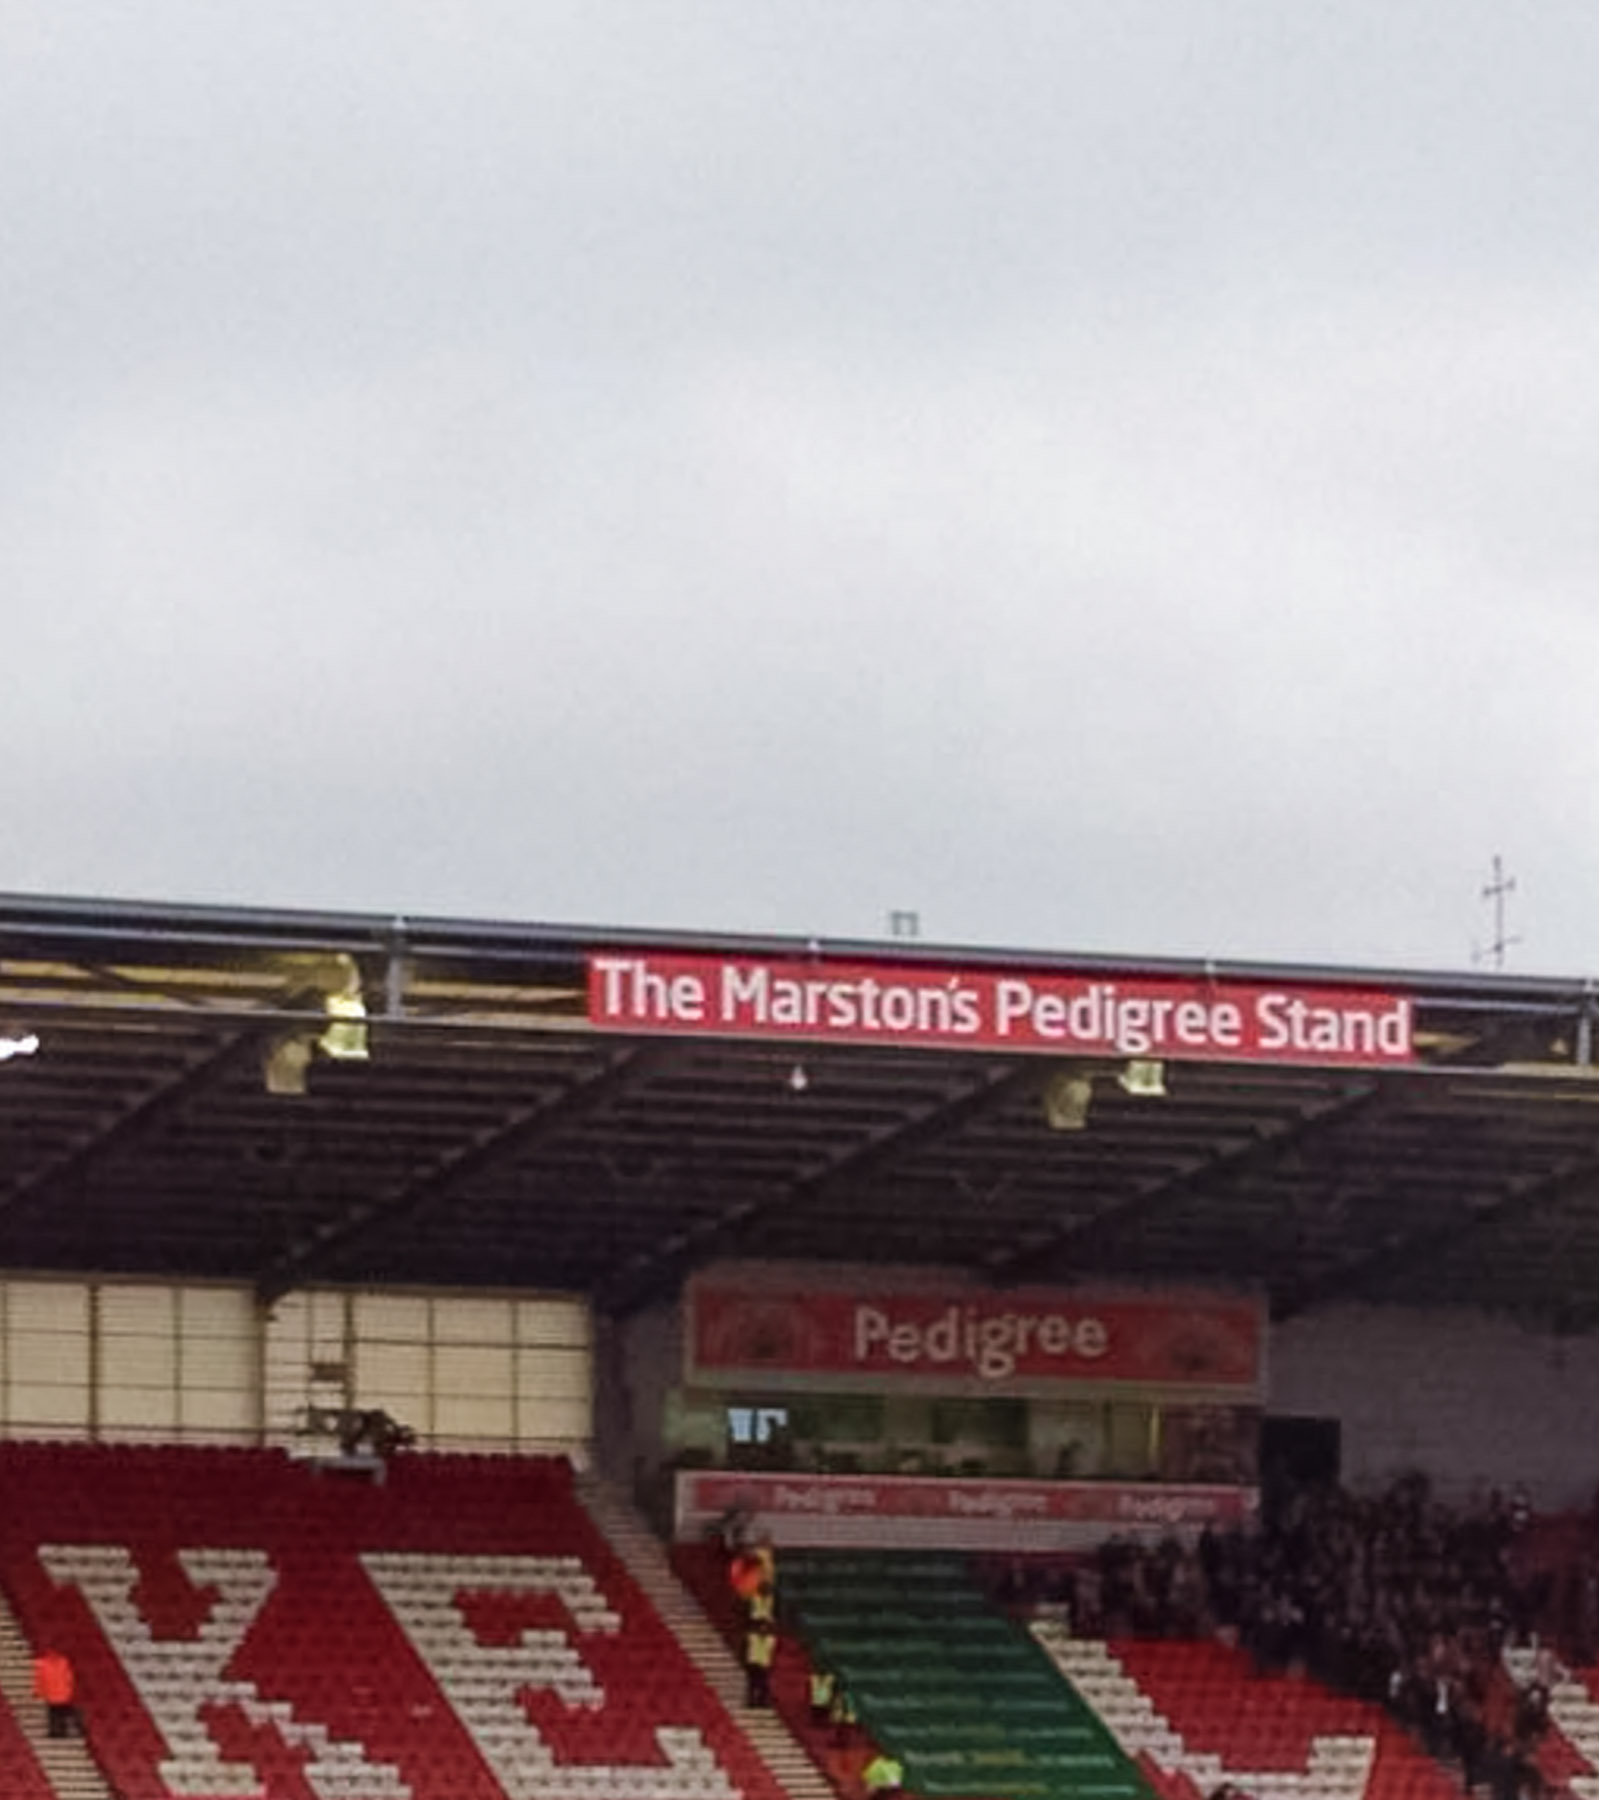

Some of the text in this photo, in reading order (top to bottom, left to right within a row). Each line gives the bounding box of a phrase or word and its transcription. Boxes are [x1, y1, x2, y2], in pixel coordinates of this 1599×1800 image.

[593, 957, 1411, 1056] The Marston's Pedigree Stand
[854, 1304, 1108, 1379] Pedigree
